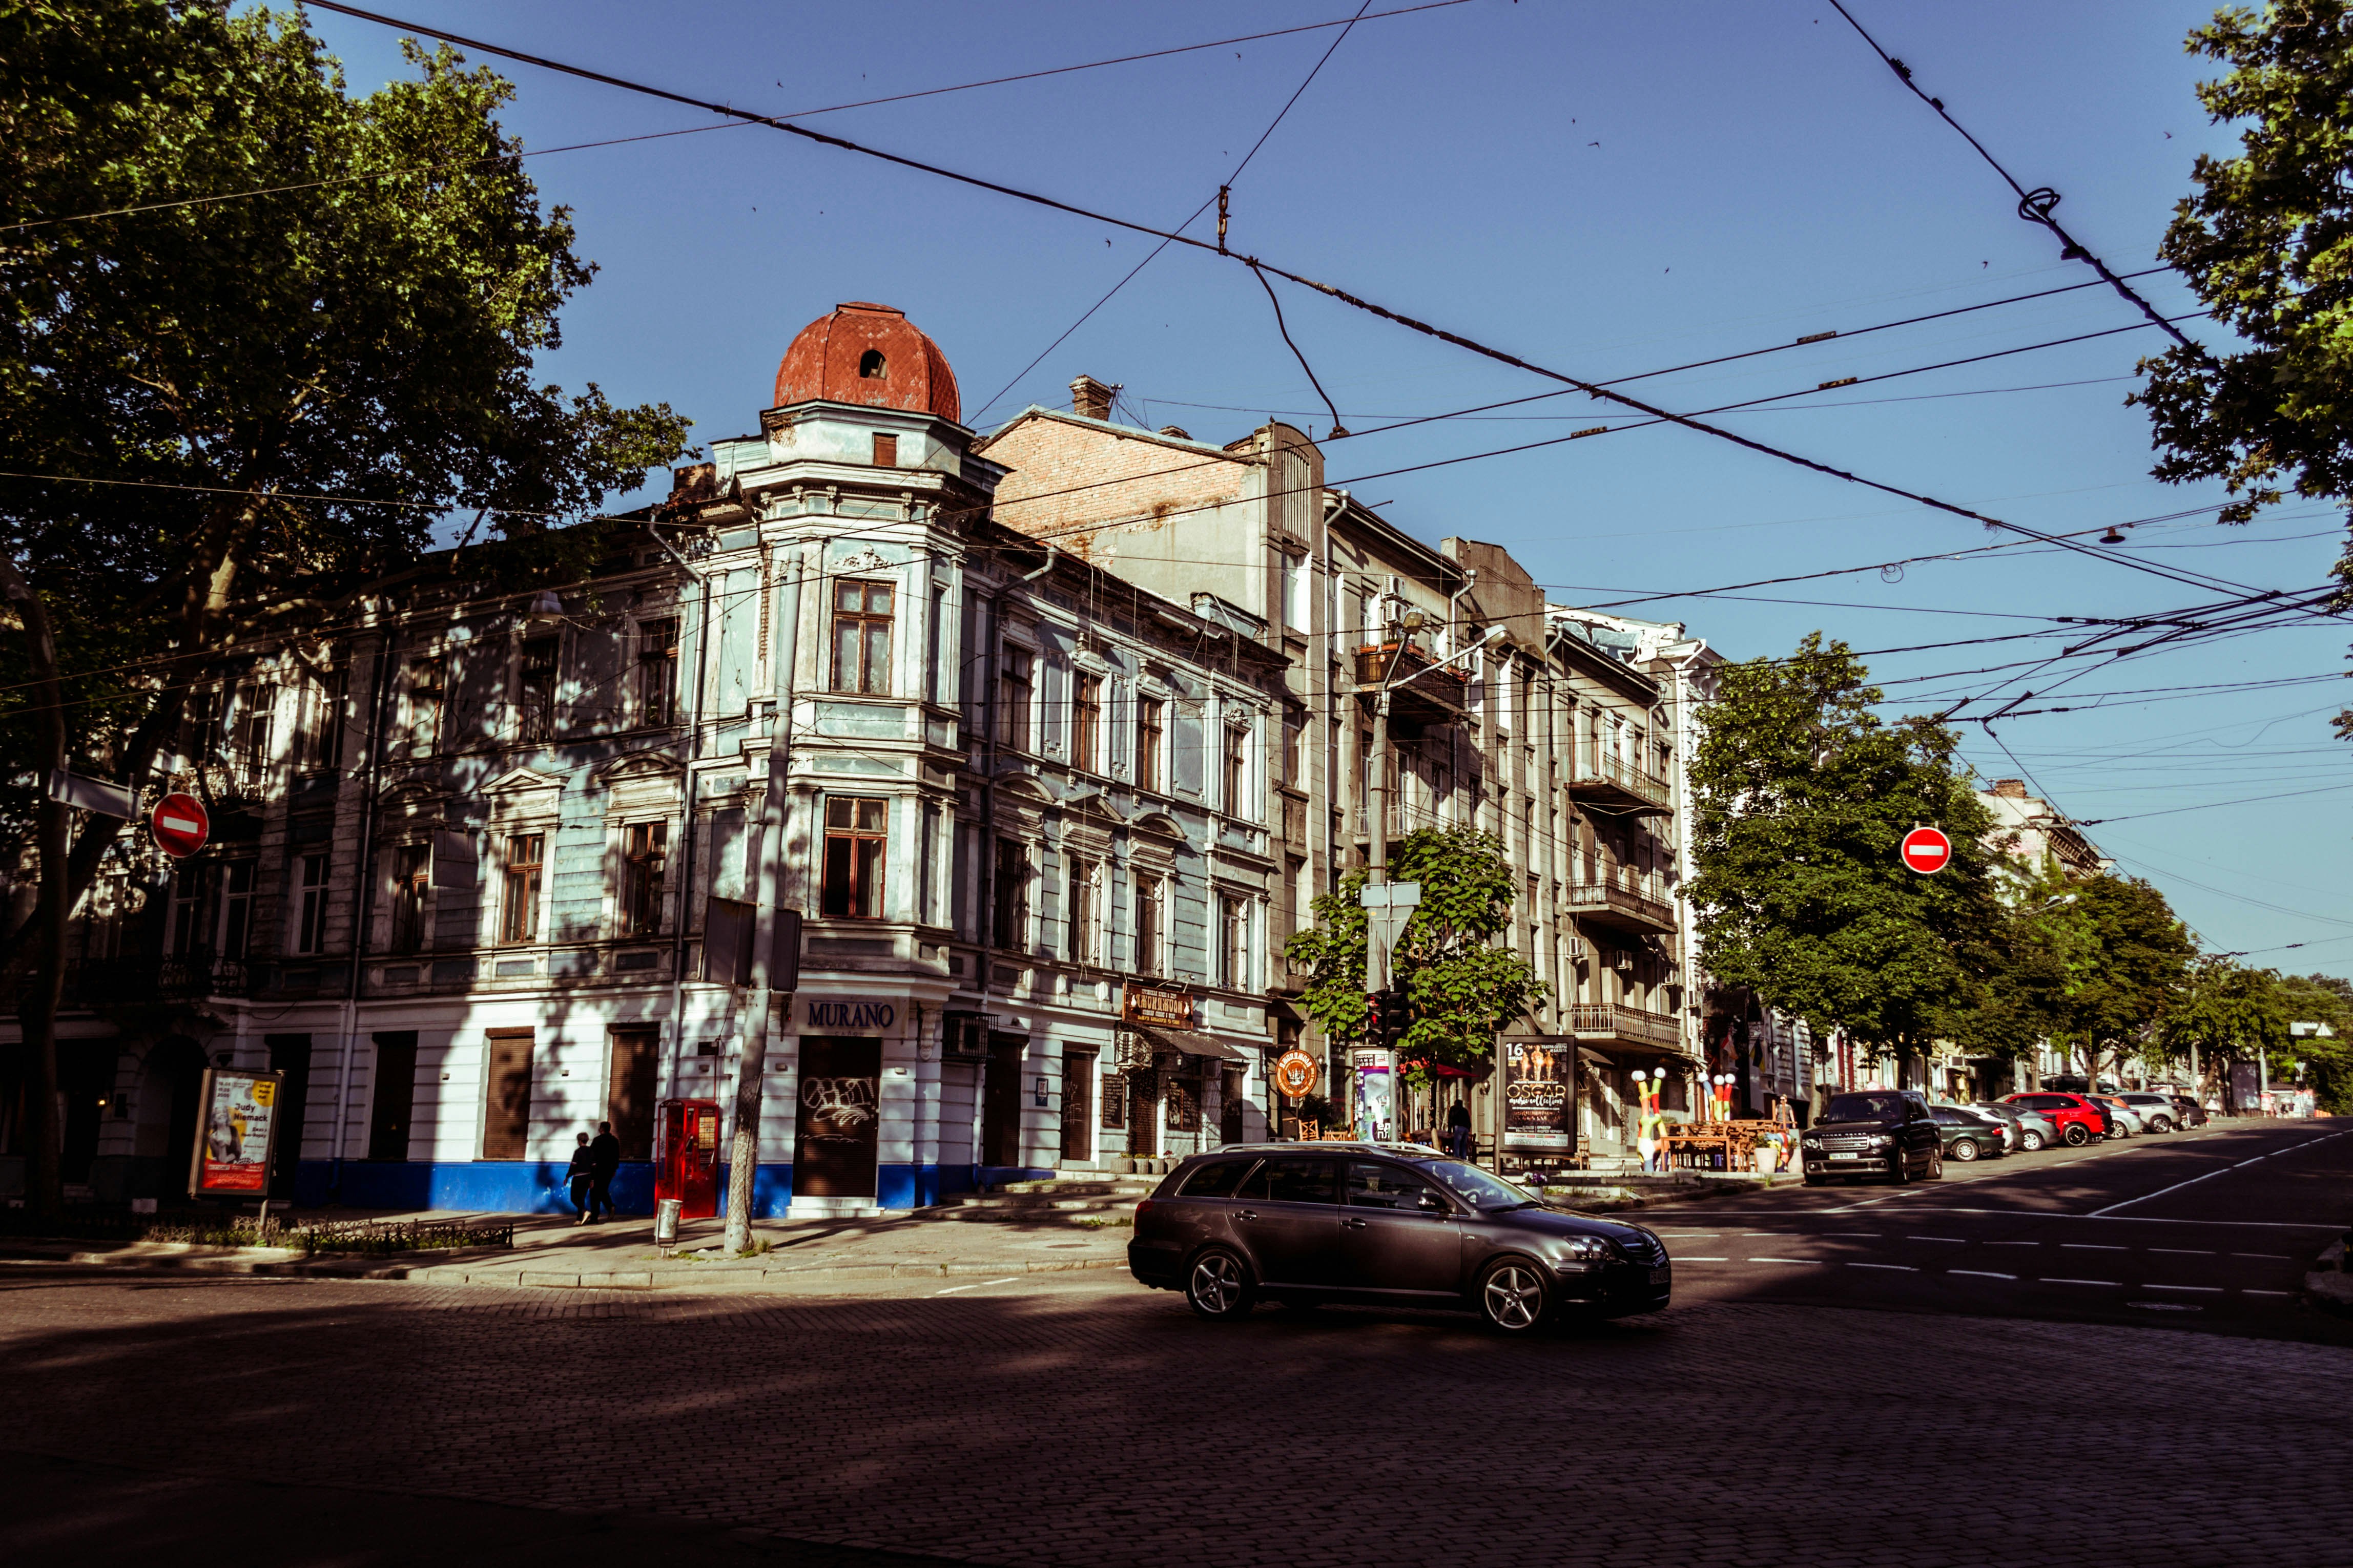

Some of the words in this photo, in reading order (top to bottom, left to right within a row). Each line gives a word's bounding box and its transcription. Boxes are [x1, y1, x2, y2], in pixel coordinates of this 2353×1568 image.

[808, 1003, 894, 1028] MURANO
[1506, 1043, 1523, 1056] 16
[1506, 1084, 1566, 1098] OSCAR
[1530, 1095, 1563, 1106] collection
[235, 1103, 255, 1112] Judy
[234, 1113, 267, 1121] Niemack
